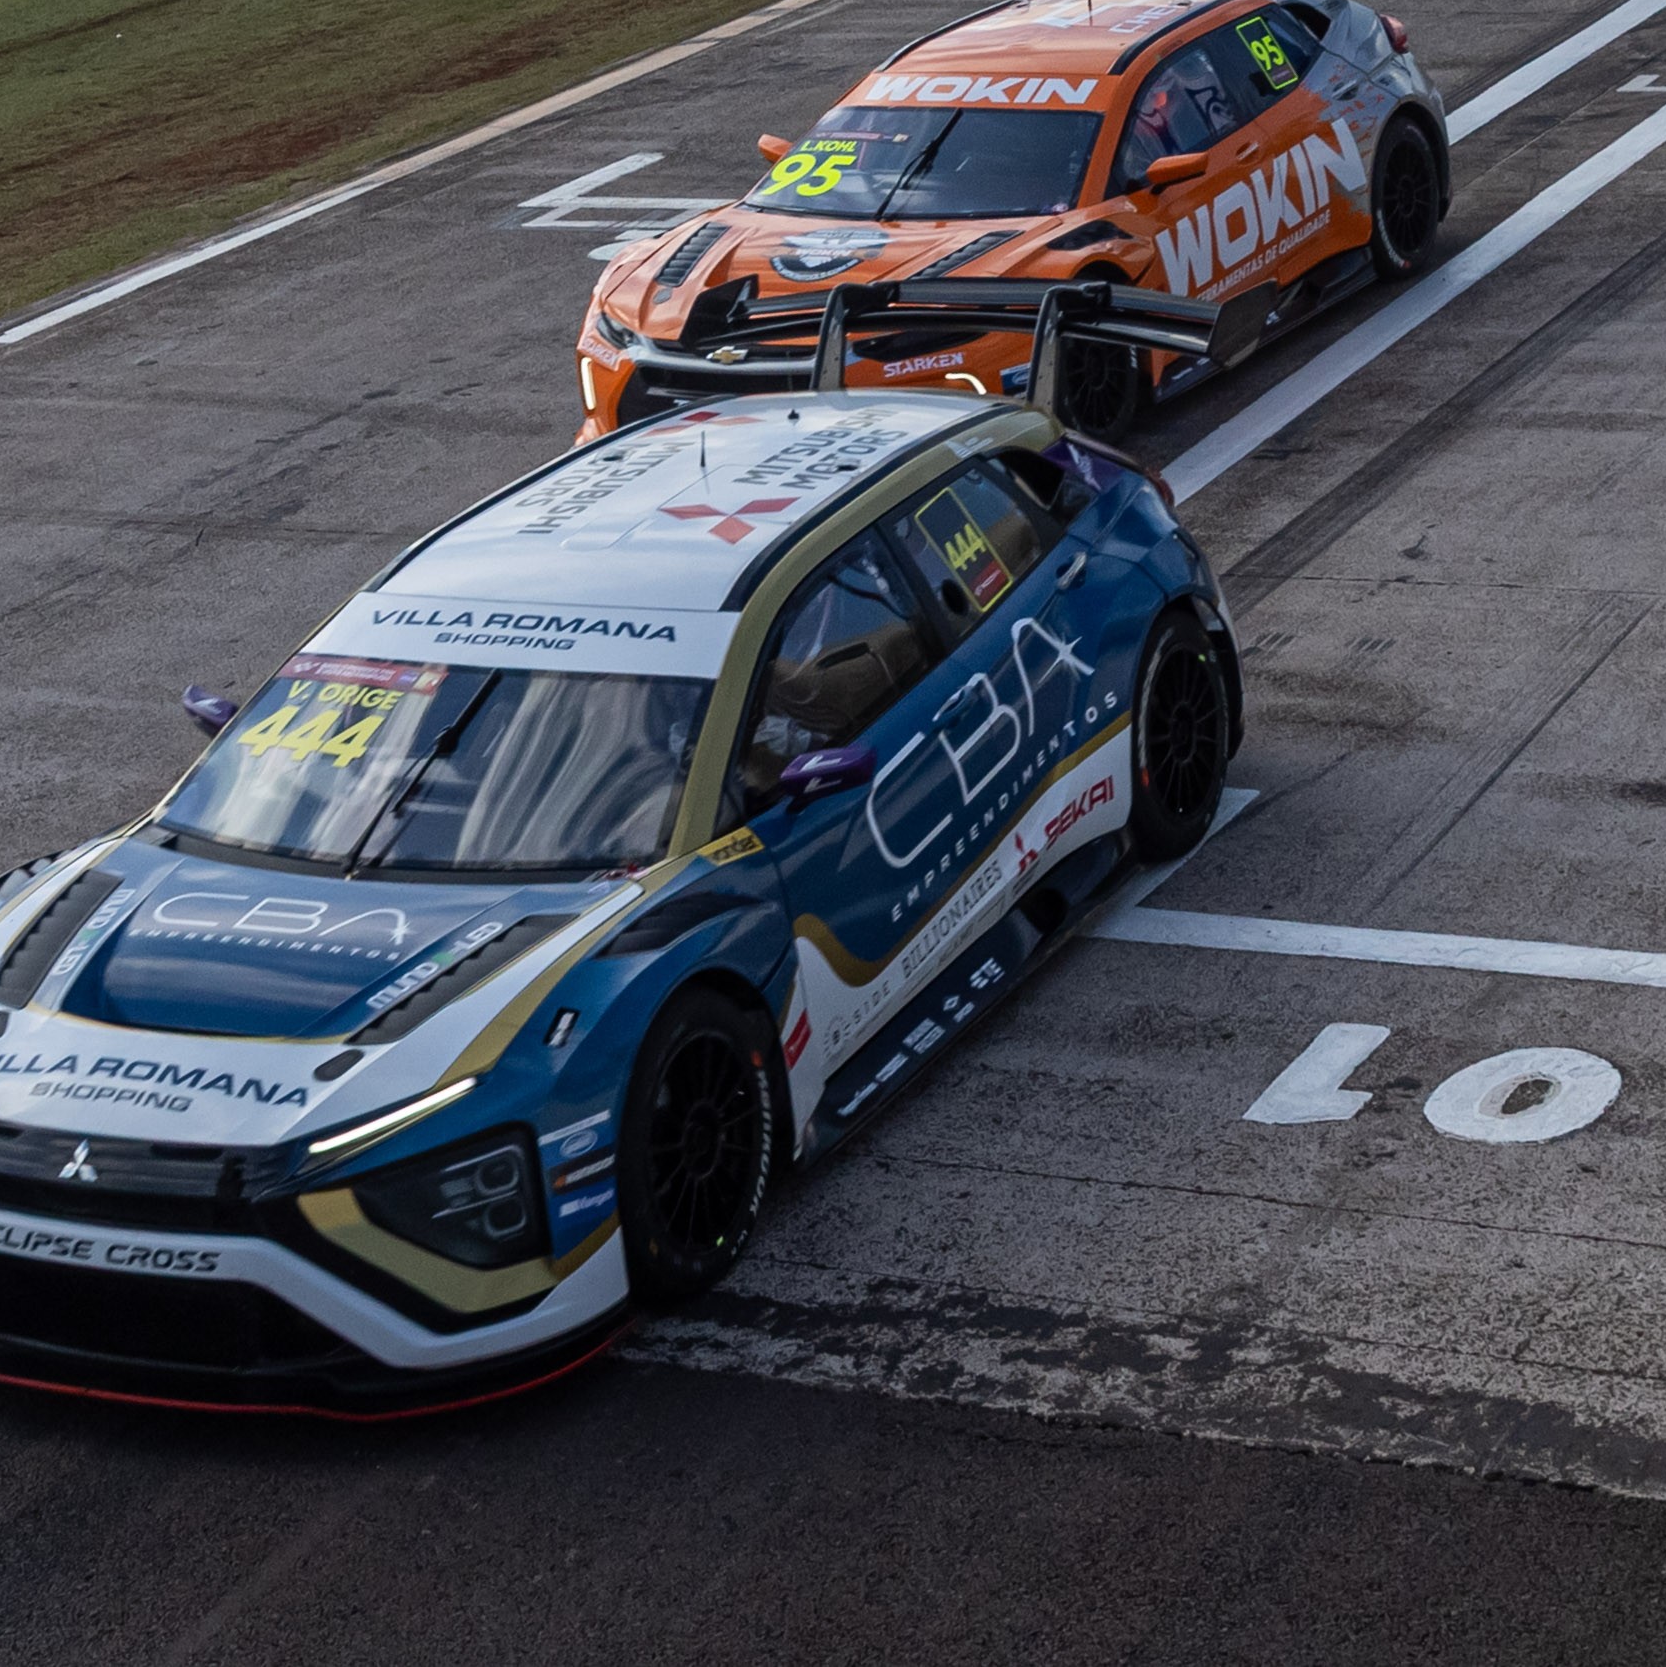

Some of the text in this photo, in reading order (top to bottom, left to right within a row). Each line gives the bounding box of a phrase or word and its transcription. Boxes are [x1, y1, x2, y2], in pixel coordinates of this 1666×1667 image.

[1250, 35, 1285, 71] 95
[864, 77, 1099, 104] WOKIN
[800, 140, 858, 153] L.KOHL
[759, 154, 857, 197] 95
[1155, 117, 1367, 297] WOKIN
[1265, 247, 1277, 265] DE
[1278, 209, 1331, 256] QUALIDADE
[883, 352, 964, 378] STARKEN
[733, 408, 900, 485] MITSUBISHI
[780, 428, 911, 490] MOTORS
[519, 440, 695, 534] MITSUBISHI
[945, 523, 987, 572] 444
[373, 610, 677, 643] VILLA ROMANA
[434, 632, 577, 651] SHOPPING
[286, 681, 404, 711] V. ORIGE
[237, 705, 386, 768] 444
[866, 617, 1096, 868] CBA
[891, 690, 1118, 923] EMPREENDIMENTOS
[1044, 775, 1115, 851] SEKAI
[153, 891, 412, 945] CBA
[900, 859, 1002, 978] BILLIONAIRES
[130, 927, 402, 961] EMPREENDIMENTOS
[30, 1081, 194, 1112] SHOPPING
[86, 1057, 310, 1108] ROMANA
[104, 1243, 222, 1273] CROSS
